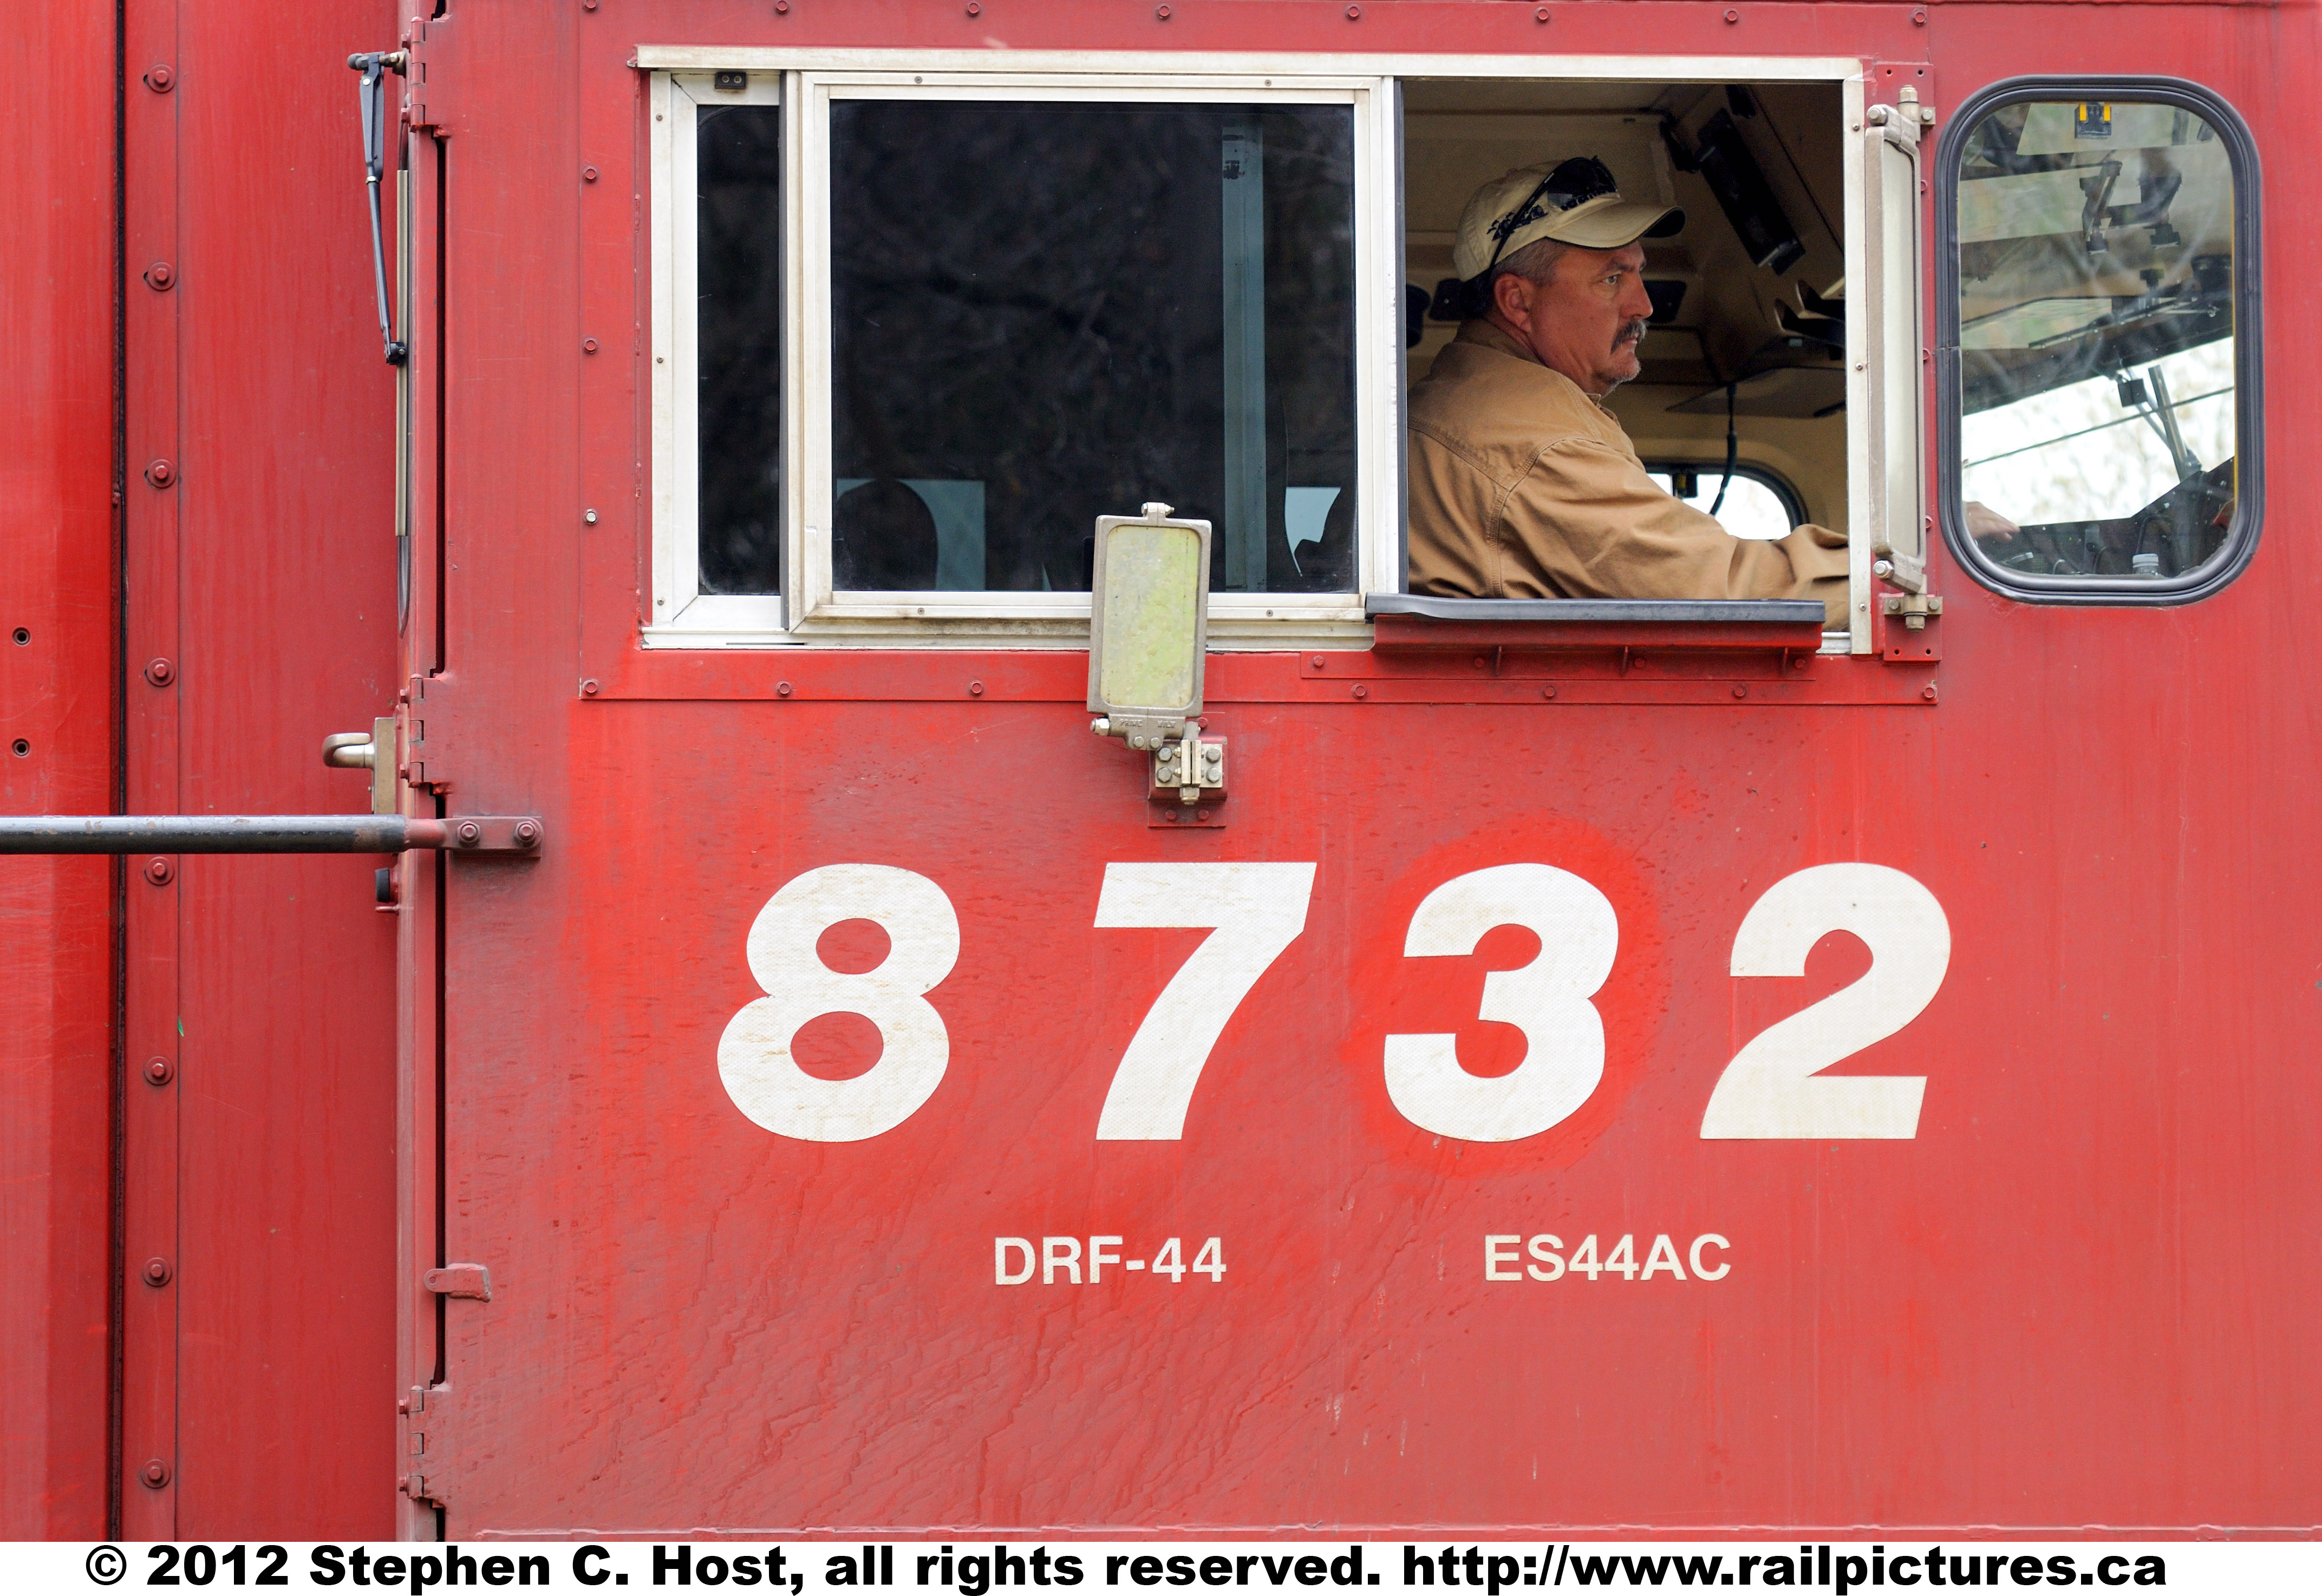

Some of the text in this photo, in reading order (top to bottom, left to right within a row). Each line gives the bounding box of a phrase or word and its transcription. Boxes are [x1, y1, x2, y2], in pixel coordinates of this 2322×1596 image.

[716, 861, 1952, 1143] 8732
[994, 1235, 1227, 1285] DRF-44
[1484, 1233, 1732, 1281] ES44AC
